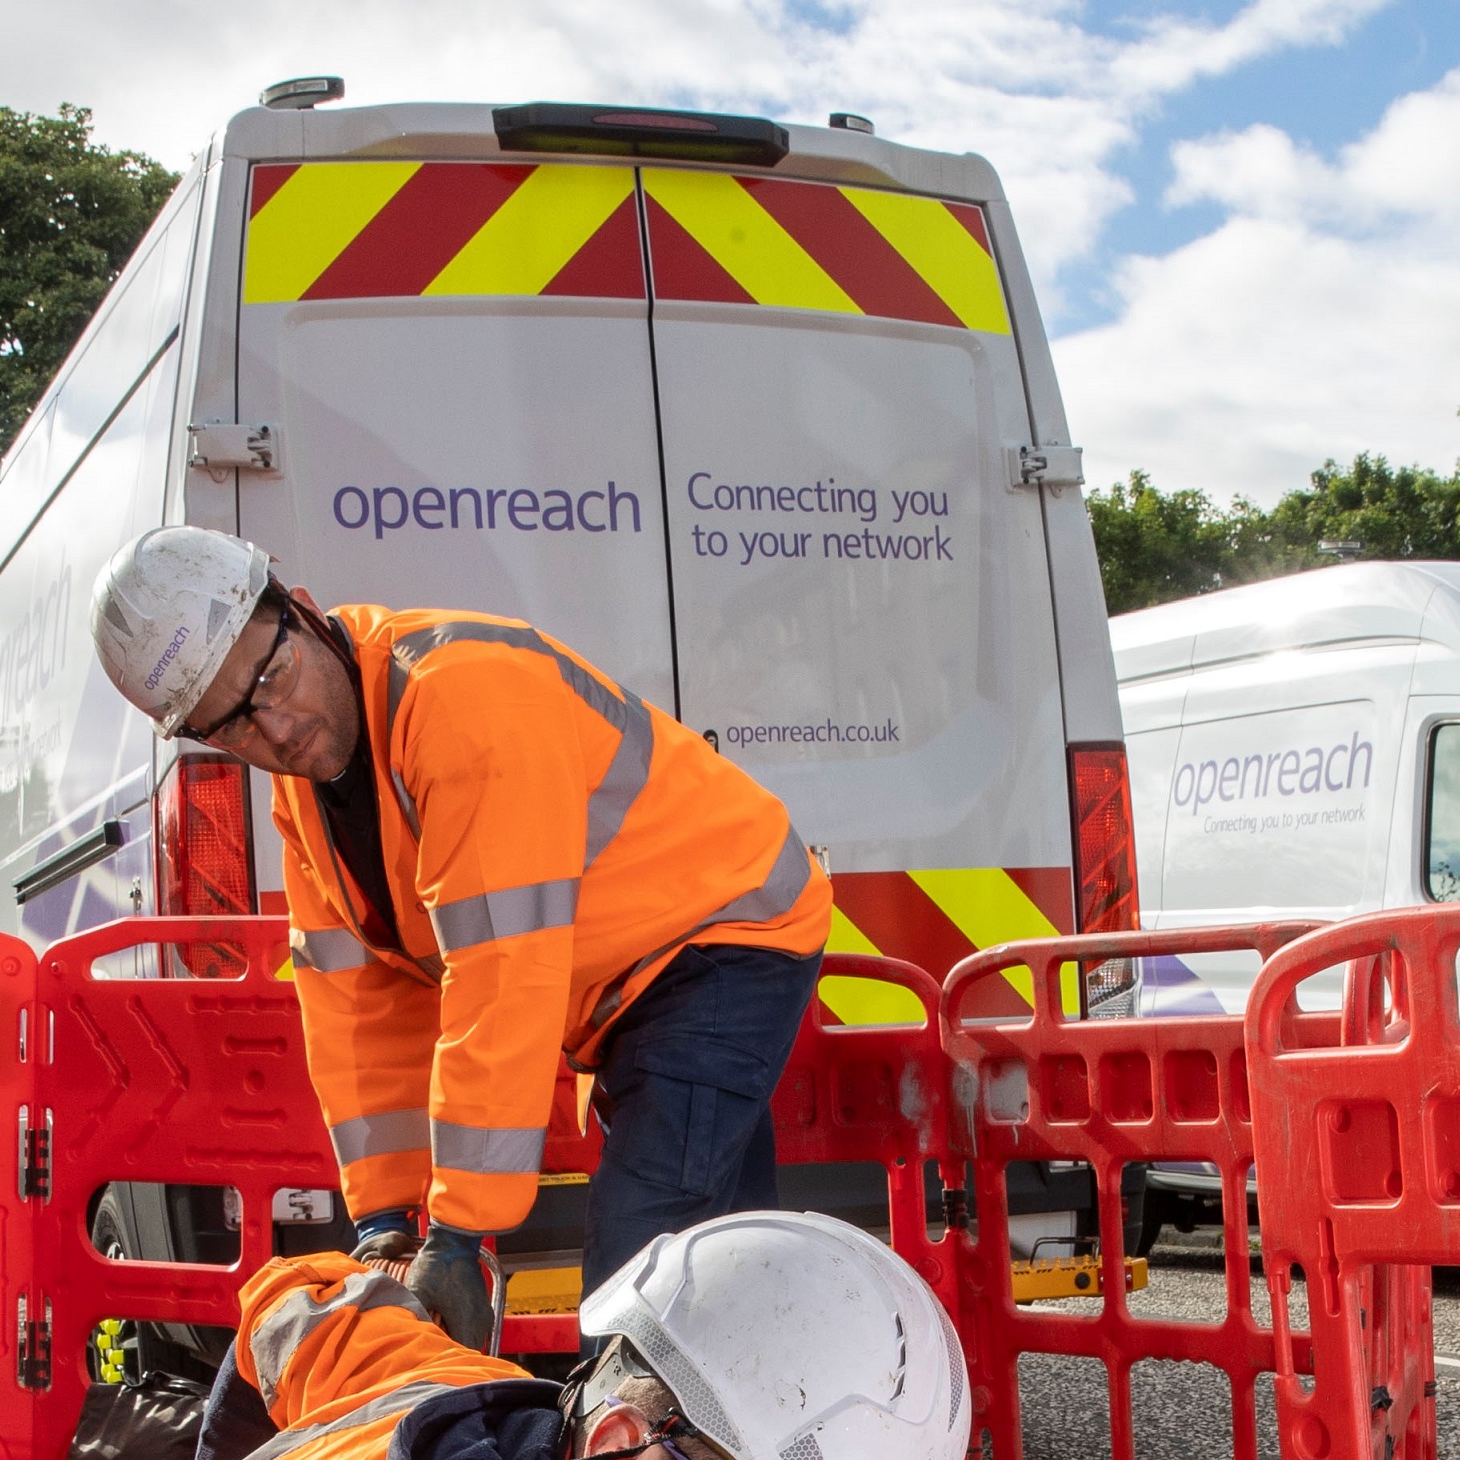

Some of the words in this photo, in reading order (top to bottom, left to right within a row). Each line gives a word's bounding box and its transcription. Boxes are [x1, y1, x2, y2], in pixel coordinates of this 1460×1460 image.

[332, 481, 642, 540] openreach
[687, 472, 878, 523] Connecting
[891, 491, 949, 523] you
[691, 524, 729, 557] to
[738, 531, 813, 566] your
[822, 525, 954, 561] network
[144, 626, 191, 690] openreach
[726, 717, 900, 749] openreach.co.uk
[1173, 730, 1374, 817] openreach
[1203, 813, 1257, 834] Connecting
[1259, 814, 1279, 834] you
[1282, 812, 1293, 827] to
[1295, 811, 1320, 831] your
[1320, 803, 1367, 825] network
